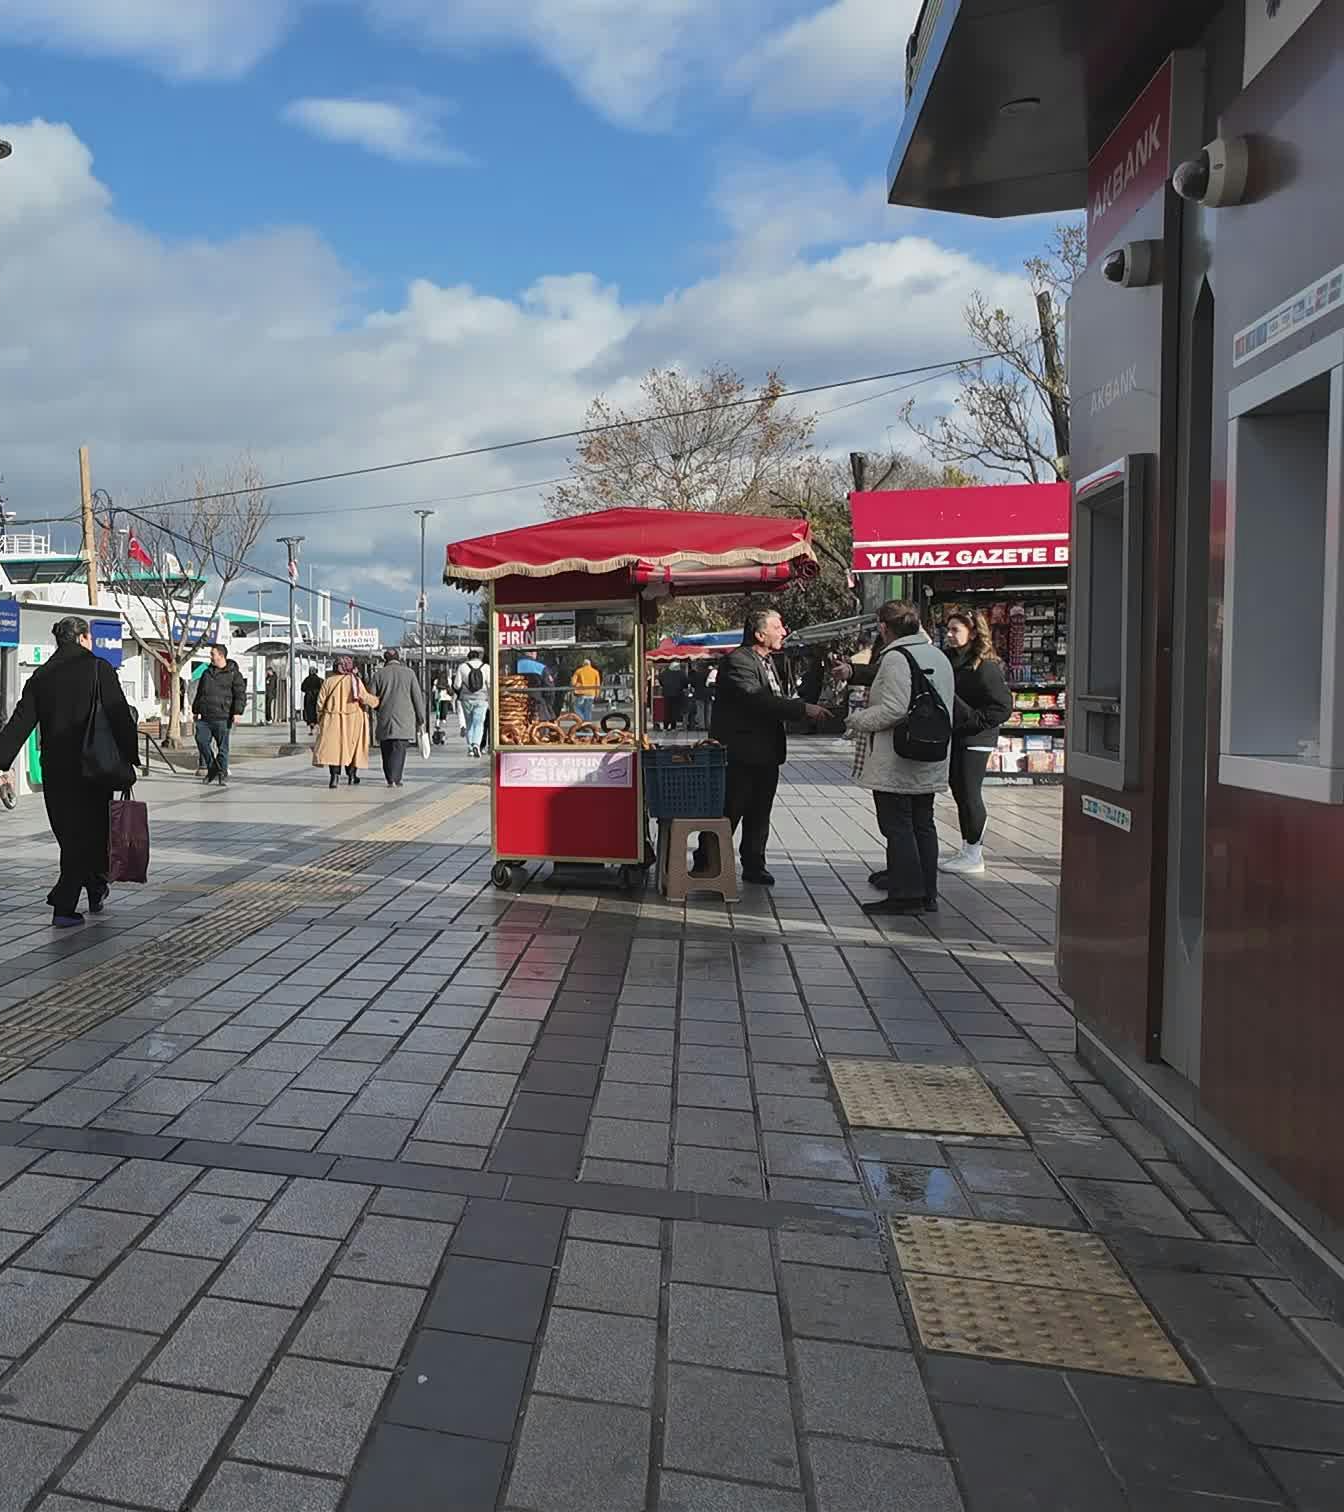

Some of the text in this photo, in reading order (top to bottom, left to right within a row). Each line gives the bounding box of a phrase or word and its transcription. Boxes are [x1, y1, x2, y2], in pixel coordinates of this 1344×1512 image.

[1092, 113, 1161, 225] AKBANK
[1089, 361, 1137, 417] AKBANK
[865, 551, 950, 568] YILMAZ
[955, 547, 1048, 565] GAZETE
[503, 613, 530, 630] TAŞ
[498, 631, 536, 645] FIRIN
